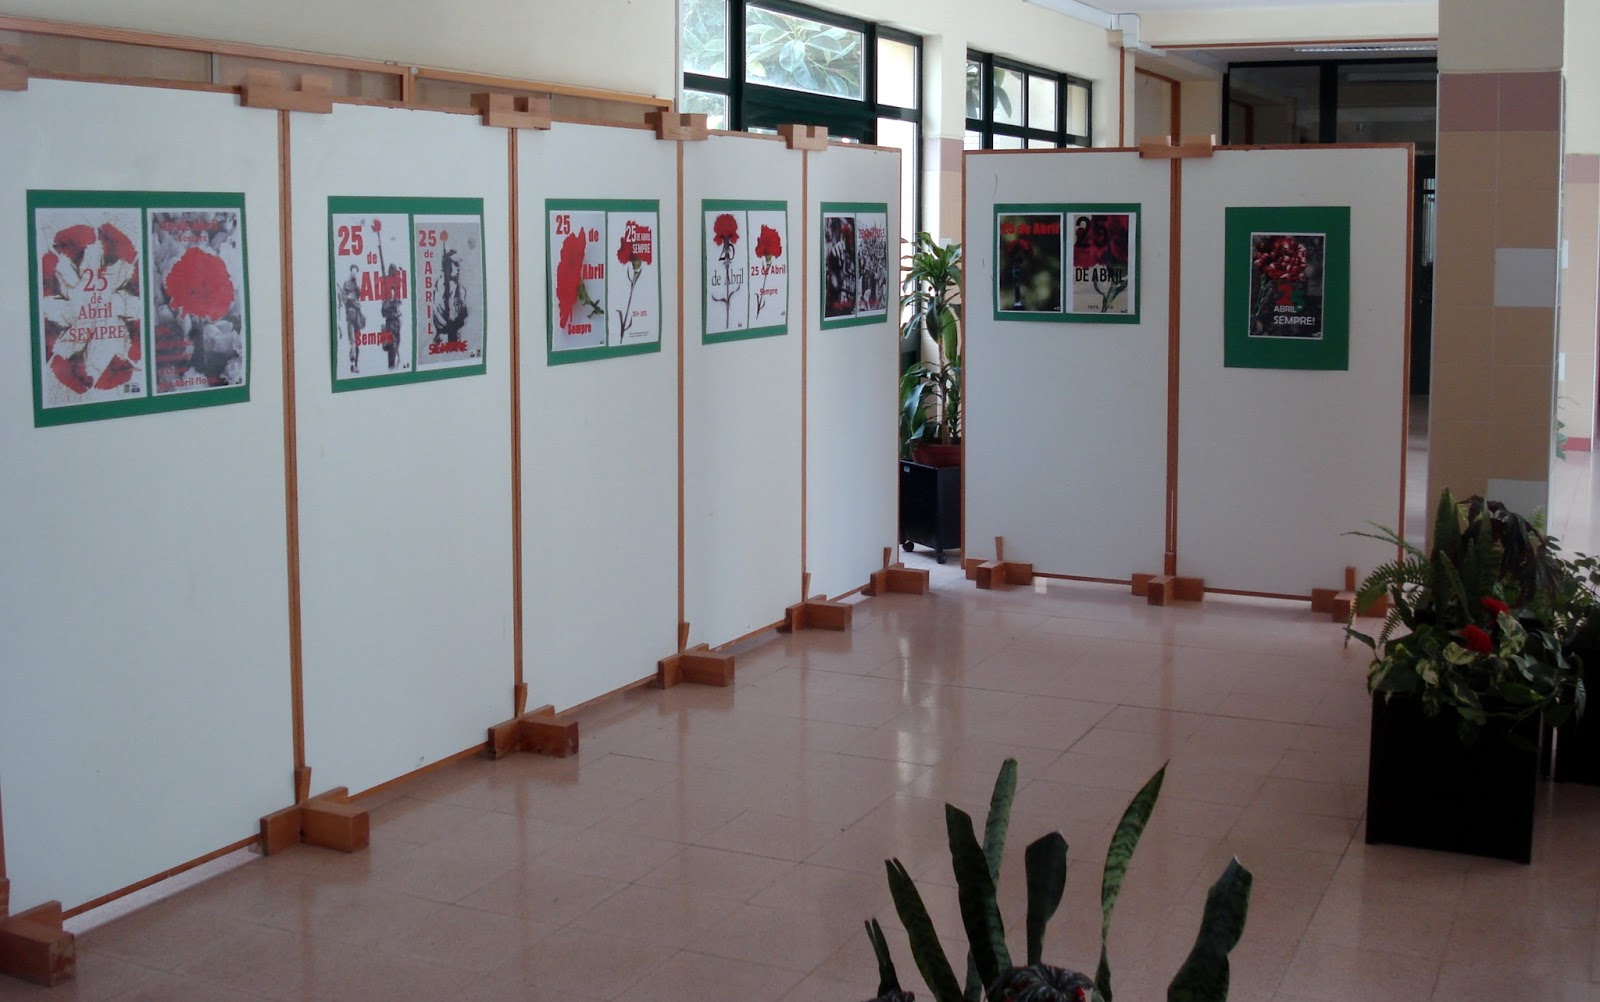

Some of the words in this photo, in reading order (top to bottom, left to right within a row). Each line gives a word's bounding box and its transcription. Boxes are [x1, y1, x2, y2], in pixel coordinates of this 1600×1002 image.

[555, 215, 571, 235] 25
[338, 225, 363, 256] 25
[418, 230, 437, 247] 25
[588, 228, 599, 242] de
[626, 225, 636, 243] 25
[367, 252, 377, 265] de
[424, 250, 434, 258] de
[582, 264, 604, 280] Abril
[711, 270, 721, 286] de
[724, 268, 744, 285] Abril
[751, 265, 759, 276] 25
[770, 264, 786, 275] Abril
[1075, 268, 1090, 282] DE
[1091, 267, 1125, 283] ABRIL
[83, 268, 108, 292] 25
[360, 269, 407, 301] Abril
[90, 292, 102, 304] de
[424, 261, 434, 335] ABRIL
[759, 288, 778, 296] Sempre
[78, 302, 113, 320] Abril
[1273, 305, 1297, 313] ABRIL
[1273, 315, 1316, 326] SEMPRE!
[69, 325, 125, 343] SEMPRE
[567, 323, 592, 335] Sempre
